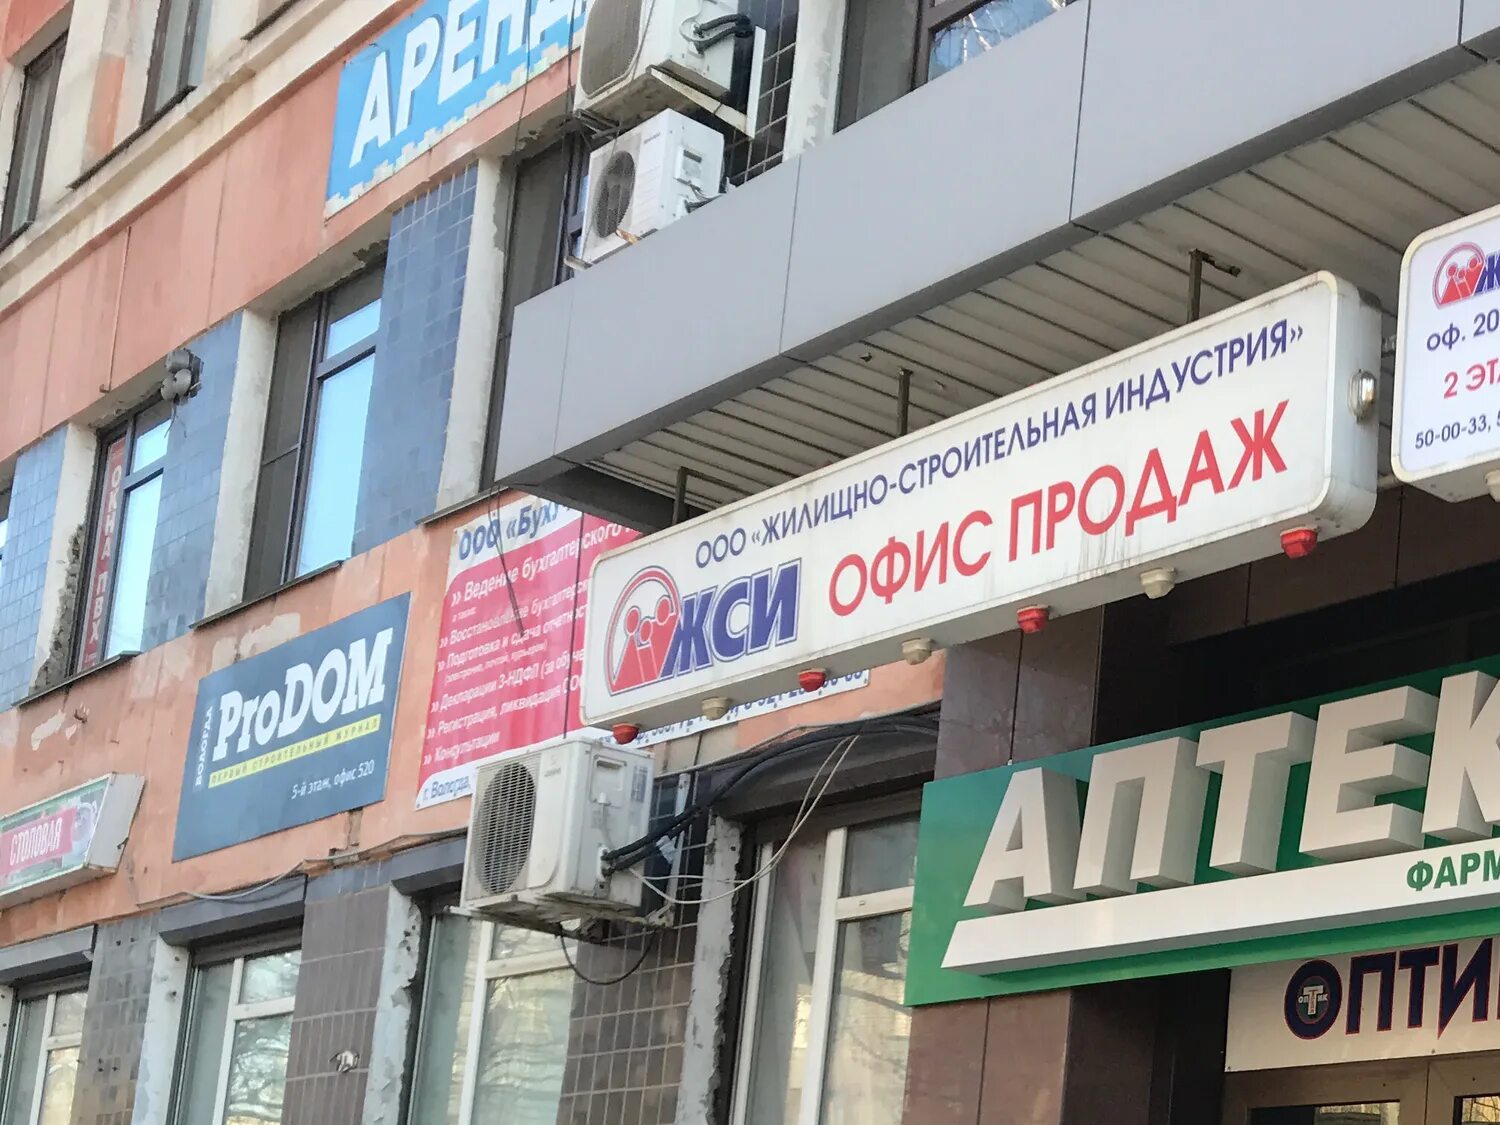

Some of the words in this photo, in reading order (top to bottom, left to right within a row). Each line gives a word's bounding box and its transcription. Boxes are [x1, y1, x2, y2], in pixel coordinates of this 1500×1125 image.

[1443, 370, 1458, 399] 2
[695, 526, 746, 568] ООО
[751, 392, 1097, 546] «ЖИЛИЩНО-СТРОИТЕЛЬНАЯ
[1105, 317, 1304, 420] ИНДУСТРИЯ»
[1414, 415, 1492, 450] 50-00-33,
[101, 464, 122, 560] ОКНА
[829, 510, 993, 617] ОФИС
[1008, 399, 1290, 562] ПРОДАЖ
[458, 518, 501, 560] ООО
[89, 571, 109, 644] ПВХ
[464, 565, 519, 602] Ведение
[660, 558, 802, 679] ЖСИ
[212, 627, 393, 761] ProDOM
[252, 733, 330, 769] СТРОИТЕЛЬНЫЙ
[335, 718, 378, 742] ЖУРНАЛ
[358, 759, 375, 779] 520
[10, 817, 63, 867] СТОЛОВАЯ
